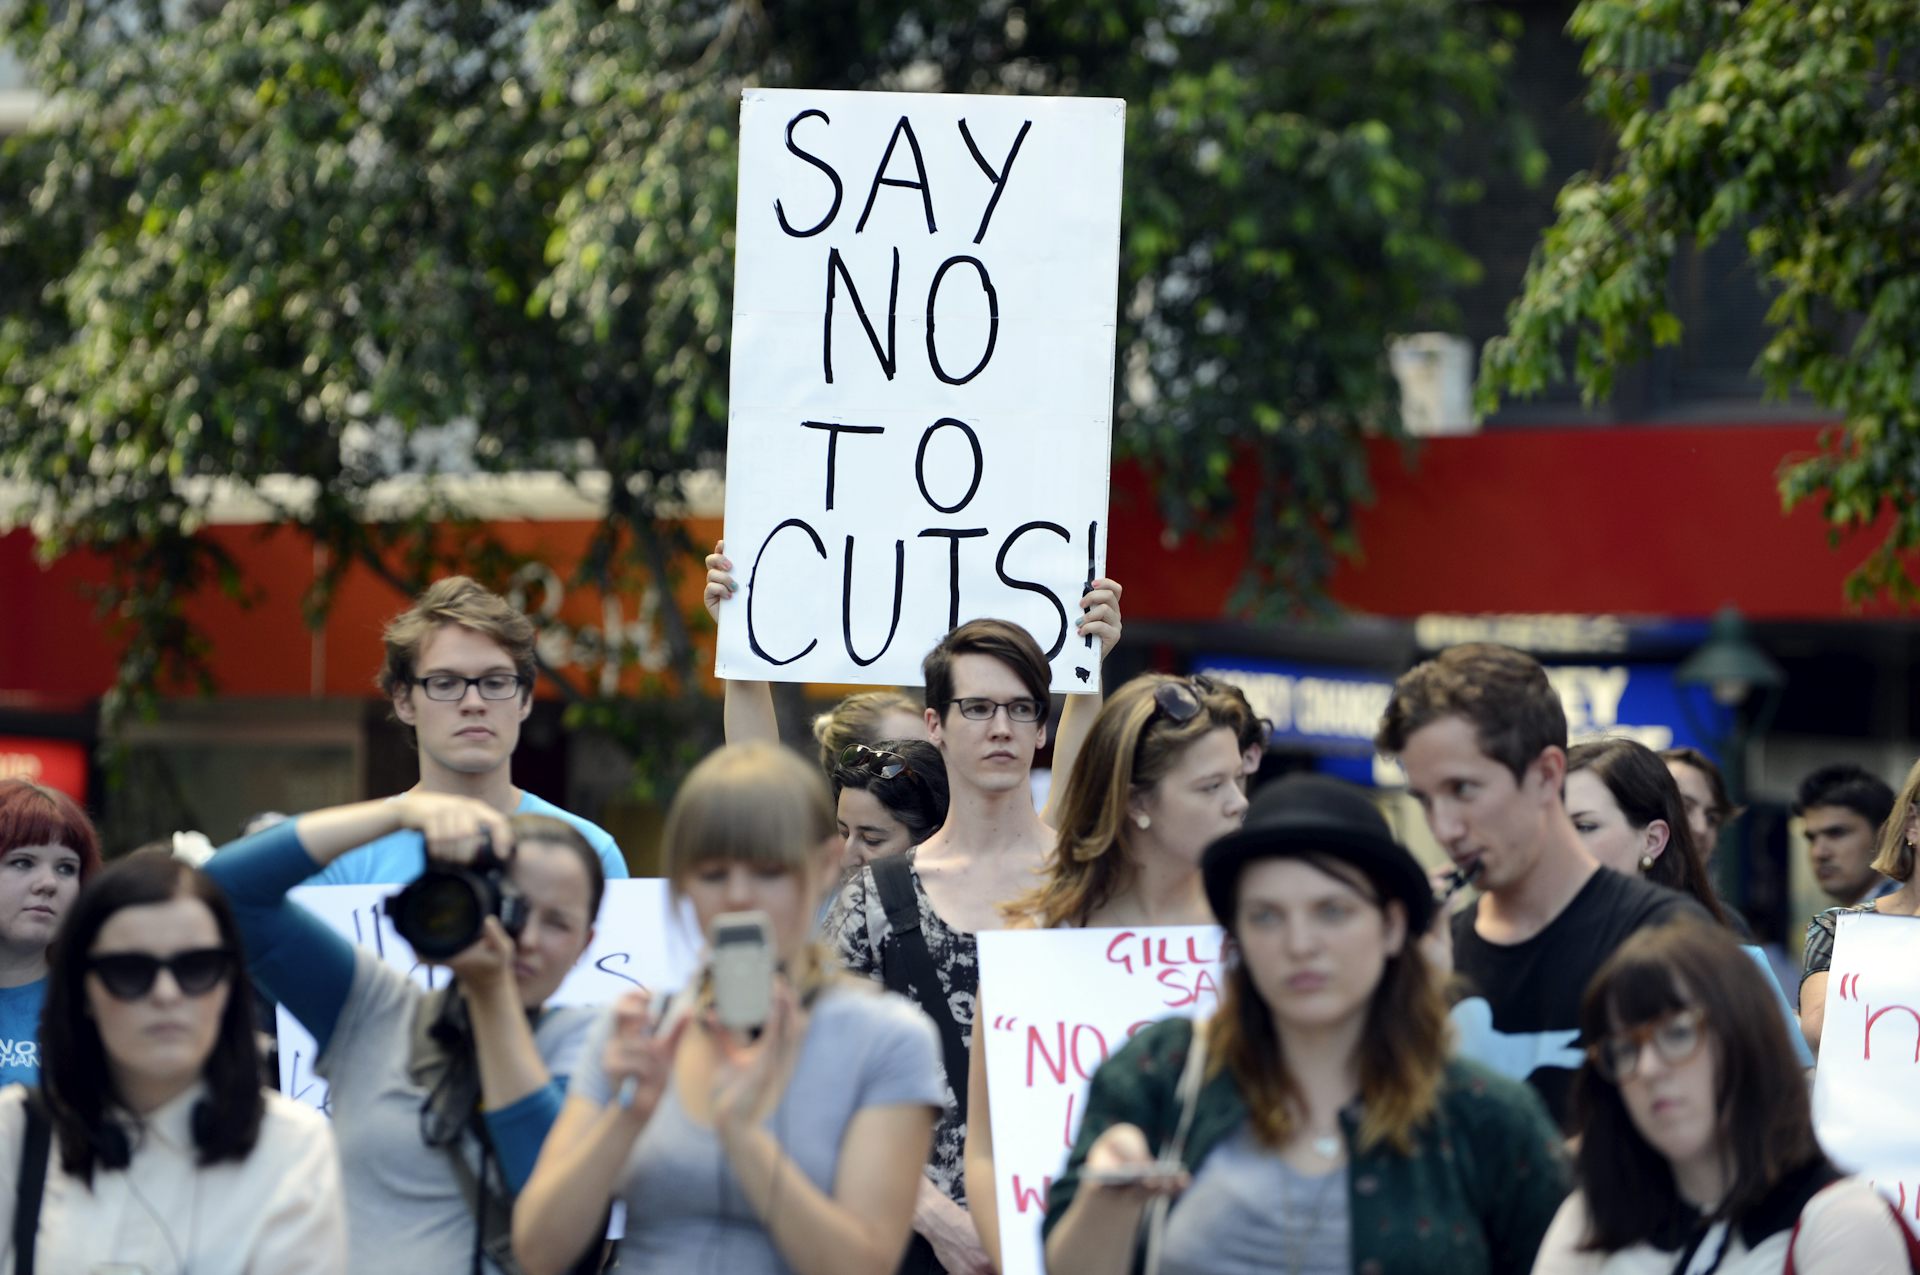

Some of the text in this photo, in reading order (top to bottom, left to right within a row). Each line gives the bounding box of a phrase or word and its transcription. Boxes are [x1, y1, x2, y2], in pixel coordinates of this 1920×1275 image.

[774, 108, 1033, 245] SAY
[823, 246, 999, 386] NO
[800, 417, 984, 515] TO
[746, 518, 1099, 684] CUTS!
